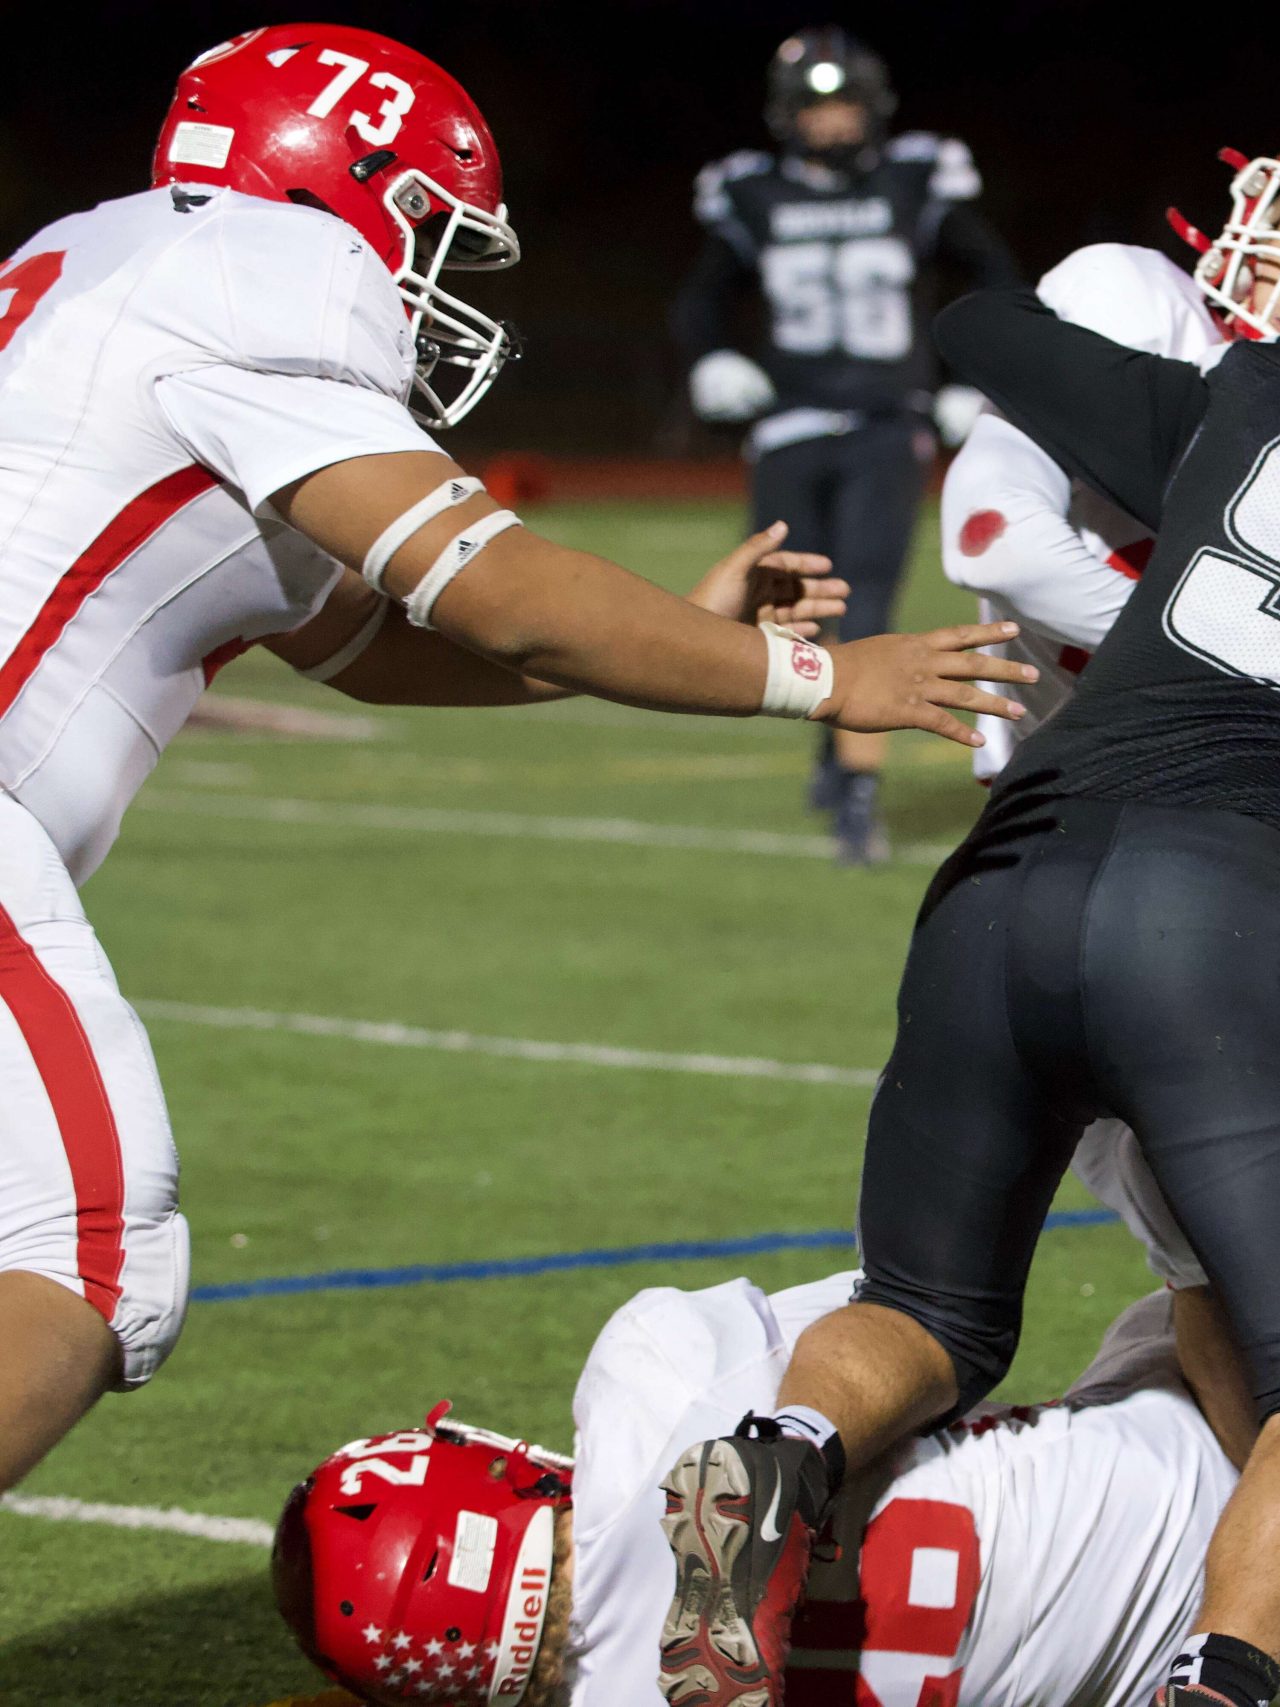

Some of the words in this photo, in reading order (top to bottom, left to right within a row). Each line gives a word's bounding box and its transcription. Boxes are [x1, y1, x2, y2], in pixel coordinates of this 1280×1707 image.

[306, 48, 416, 146] 73
[759, 237, 915, 362] 56
[335, 1432, 434, 1496] 26
[497, 1566, 548, 1698] Riddell
